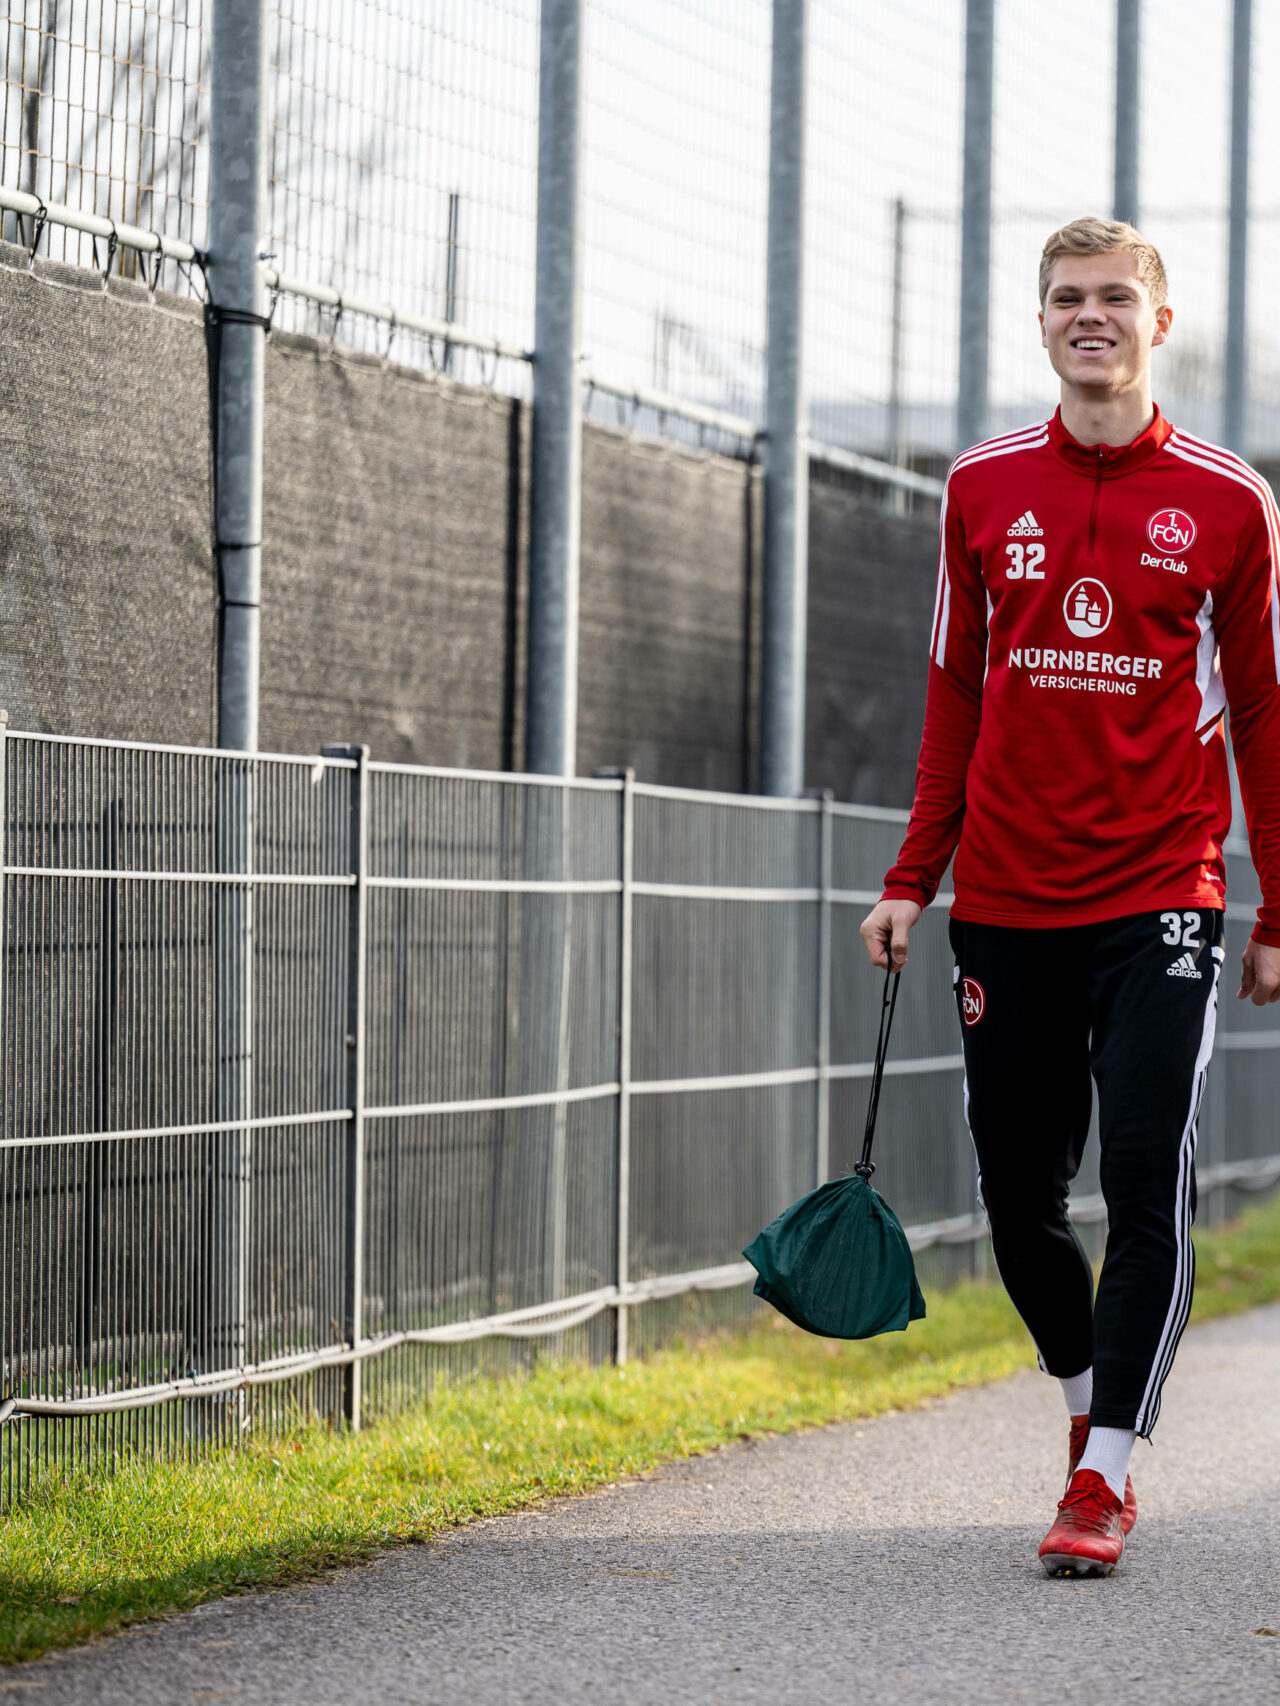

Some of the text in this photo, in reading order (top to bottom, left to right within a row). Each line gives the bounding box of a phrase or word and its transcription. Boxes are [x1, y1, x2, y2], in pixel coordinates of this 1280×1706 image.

[1168, 512, 1178, 528] 1.
[1006, 526, 1044, 537] adidas
[1152, 525, 1189, 546] FCN
[1005, 543, 1046, 580] 32
[1140, 553, 1188, 575] Der Club
[1008, 647, 1163, 679] NÜRNBERGER
[1029, 674, 1137, 696] VERSICHERUNG
[1160, 911, 1201, 948] 32
[1166, 965, 1202, 980] adidas
